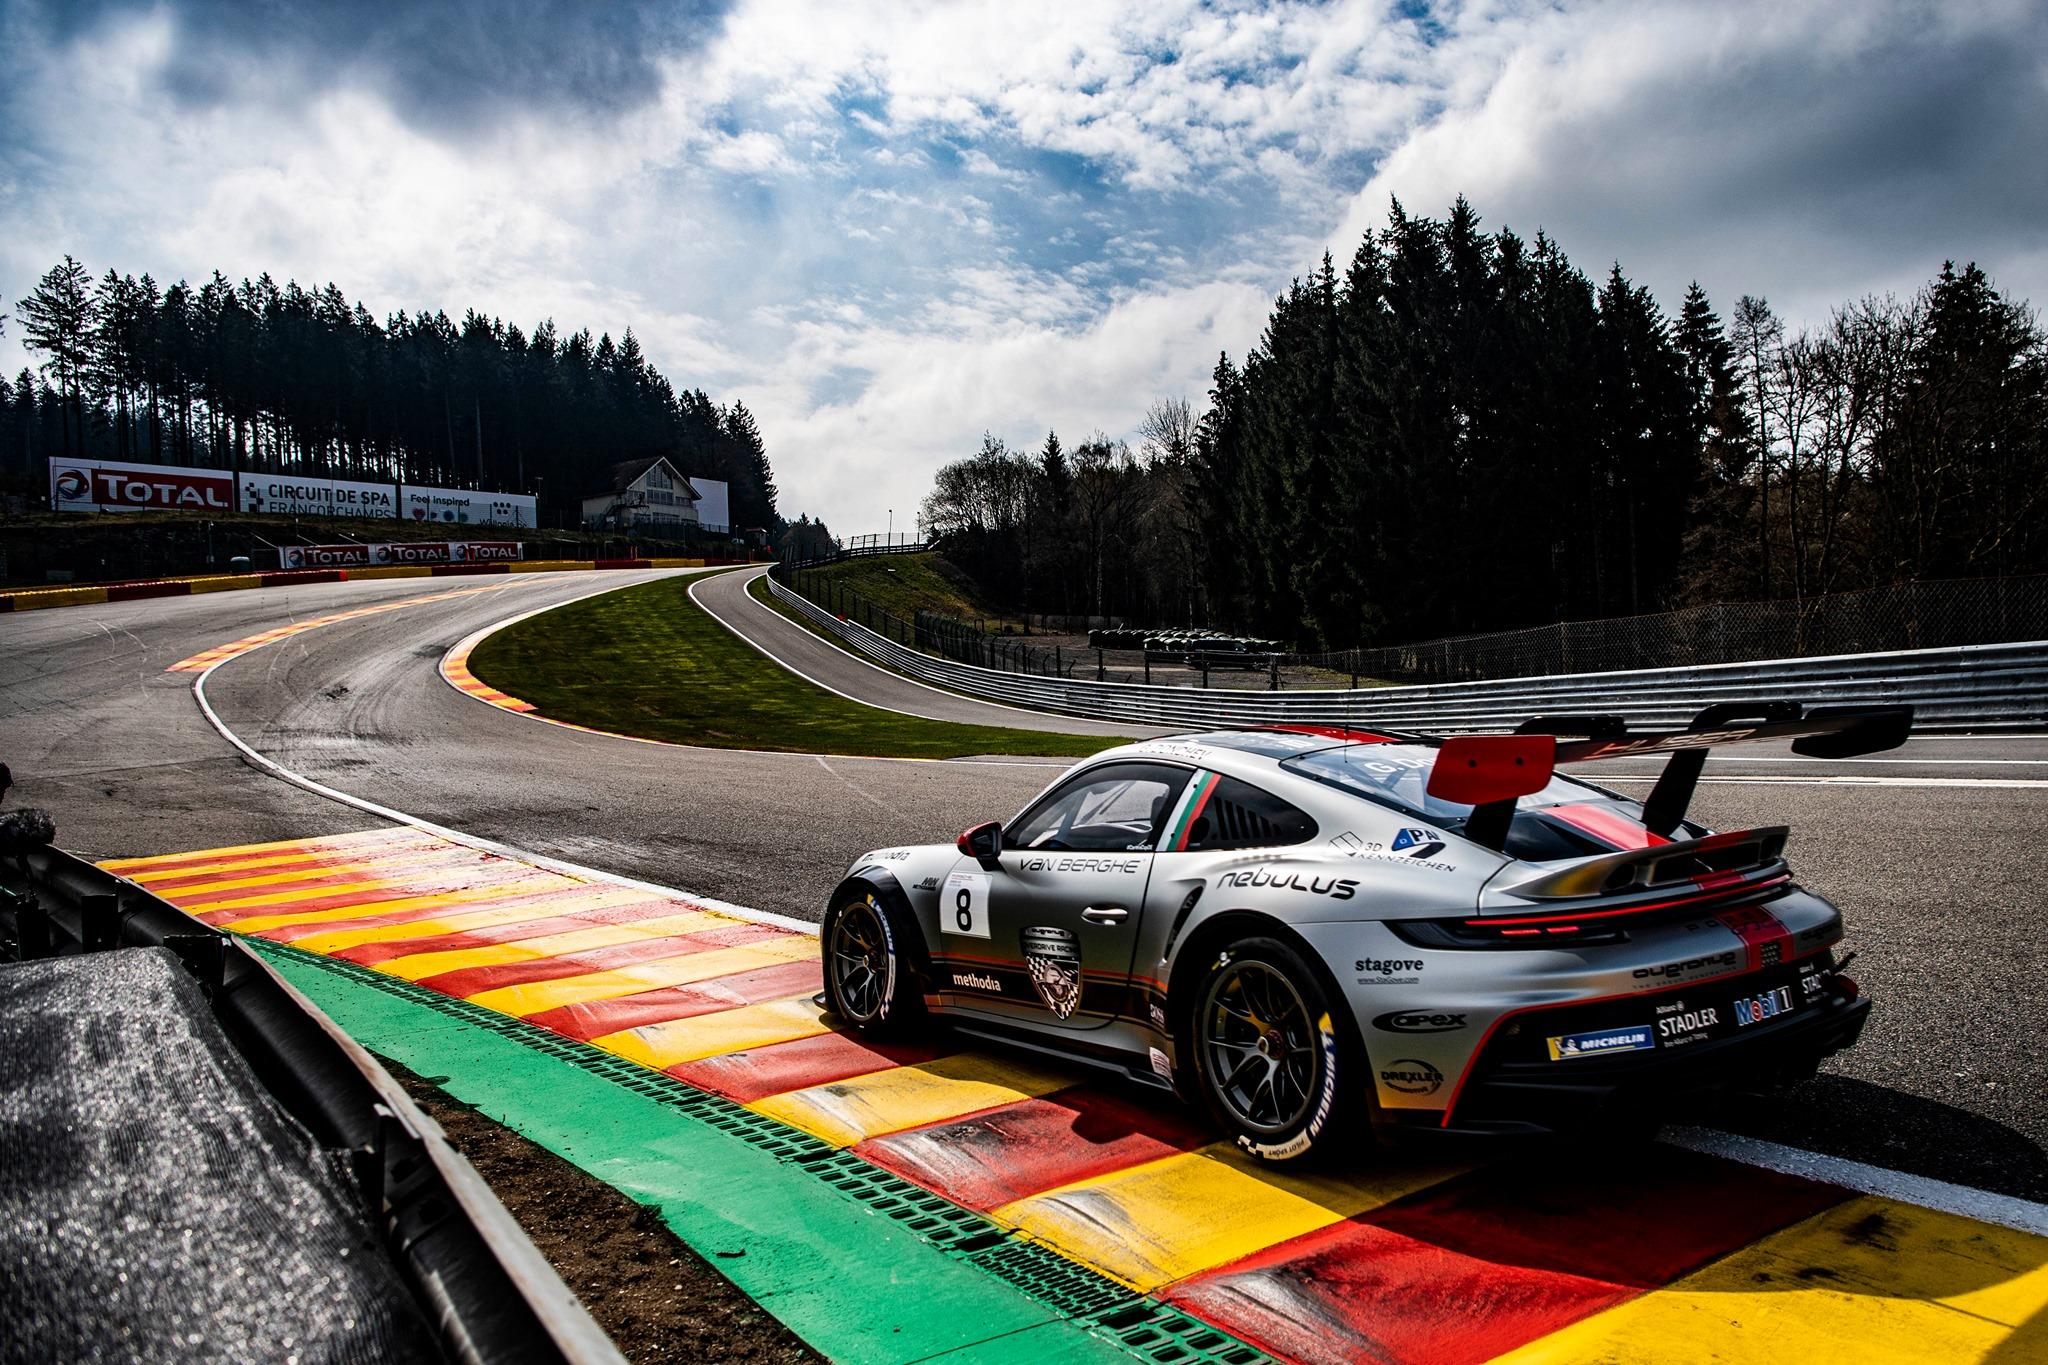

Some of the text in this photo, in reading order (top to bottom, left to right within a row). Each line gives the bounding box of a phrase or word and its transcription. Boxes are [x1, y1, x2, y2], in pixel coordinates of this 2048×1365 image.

[97, 474, 229, 508] TOTAL
[268, 484, 391, 506] CIRCUIT DE SPA
[306, 549, 368, 564] TOTAL
[393, 547, 448, 561] TOTAL
[469, 545, 517, 558] TOTAL
[1057, 858, 1141, 874] BERGHE
[956, 888, 972, 932] 8
[1355, 957, 1425, 976] stagove
[953, 973, 1002, 992] methodia
[1734, 989, 1780, 1027] Mobil
[1658, 1007, 1720, 1038] STADLER
[1581, 1033, 1646, 1050] MICHELIN
[1381, 1071, 1444, 1083] DREXLER
[1309, 1050, 1336, 1138] MICHELIN
